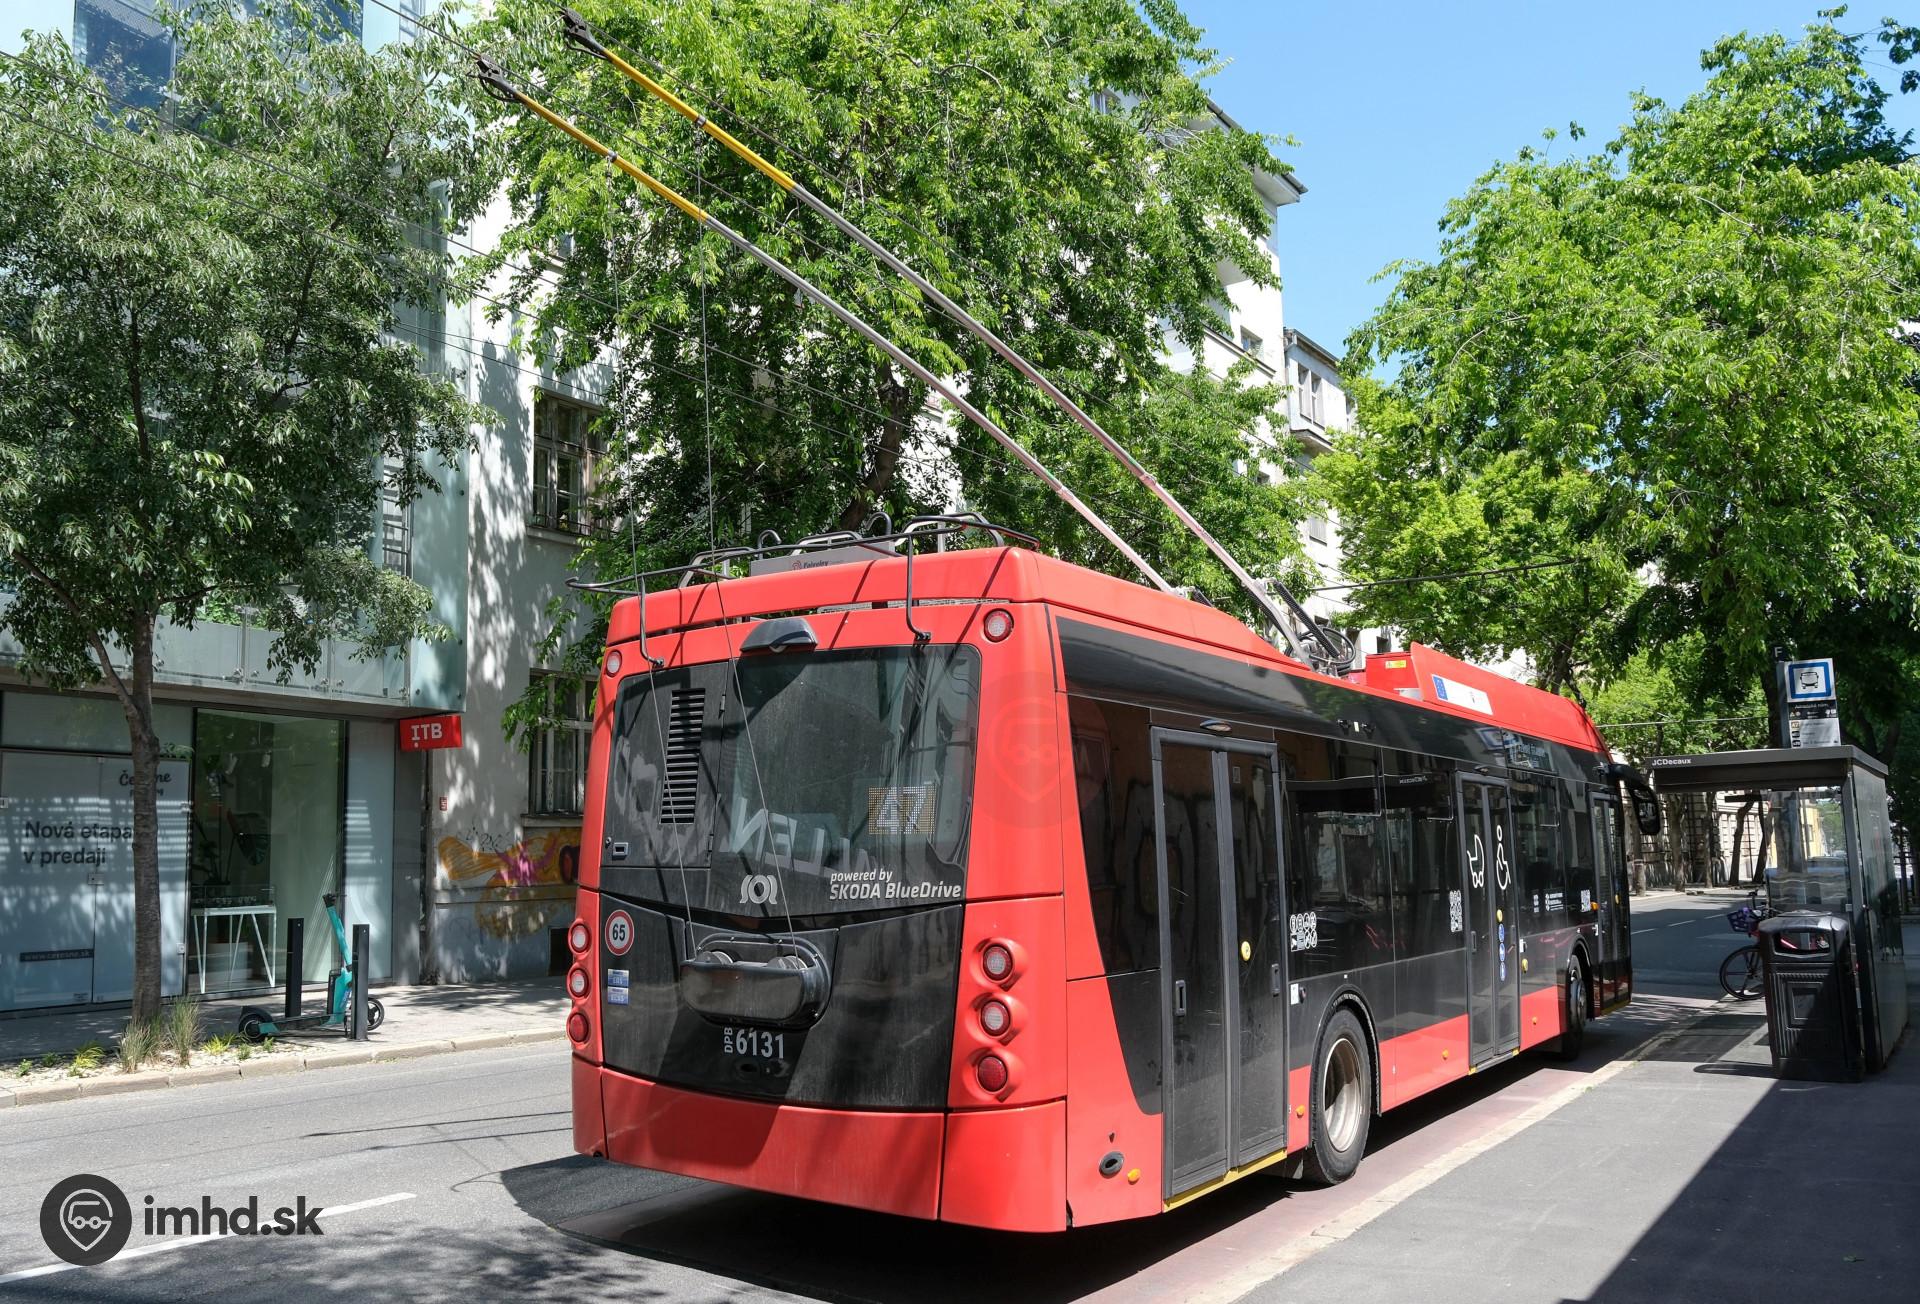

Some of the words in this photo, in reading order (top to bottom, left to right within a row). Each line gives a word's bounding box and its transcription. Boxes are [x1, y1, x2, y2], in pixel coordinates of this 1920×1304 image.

[1774, 646, 1783, 658] F
[411, 723, 443, 748] ITB
[1651, 758, 1692, 766] JCDecaux
[119, 769, 172, 787] Čene
[876, 786, 926, 834] 47
[25, 821, 75, 839] Nová
[80, 823, 133, 843] etapa
[23, 850, 34, 864] v
[40, 848, 106, 868] predaji
[830, 868, 876, 885] powered
[878, 868, 893, 883] by
[885, 880, 962, 899] BlueDrive
[612, 923, 626, 942] 65
[723, 1027, 733, 1053] DPB
[735, 1028, 784, 1059] 6131
